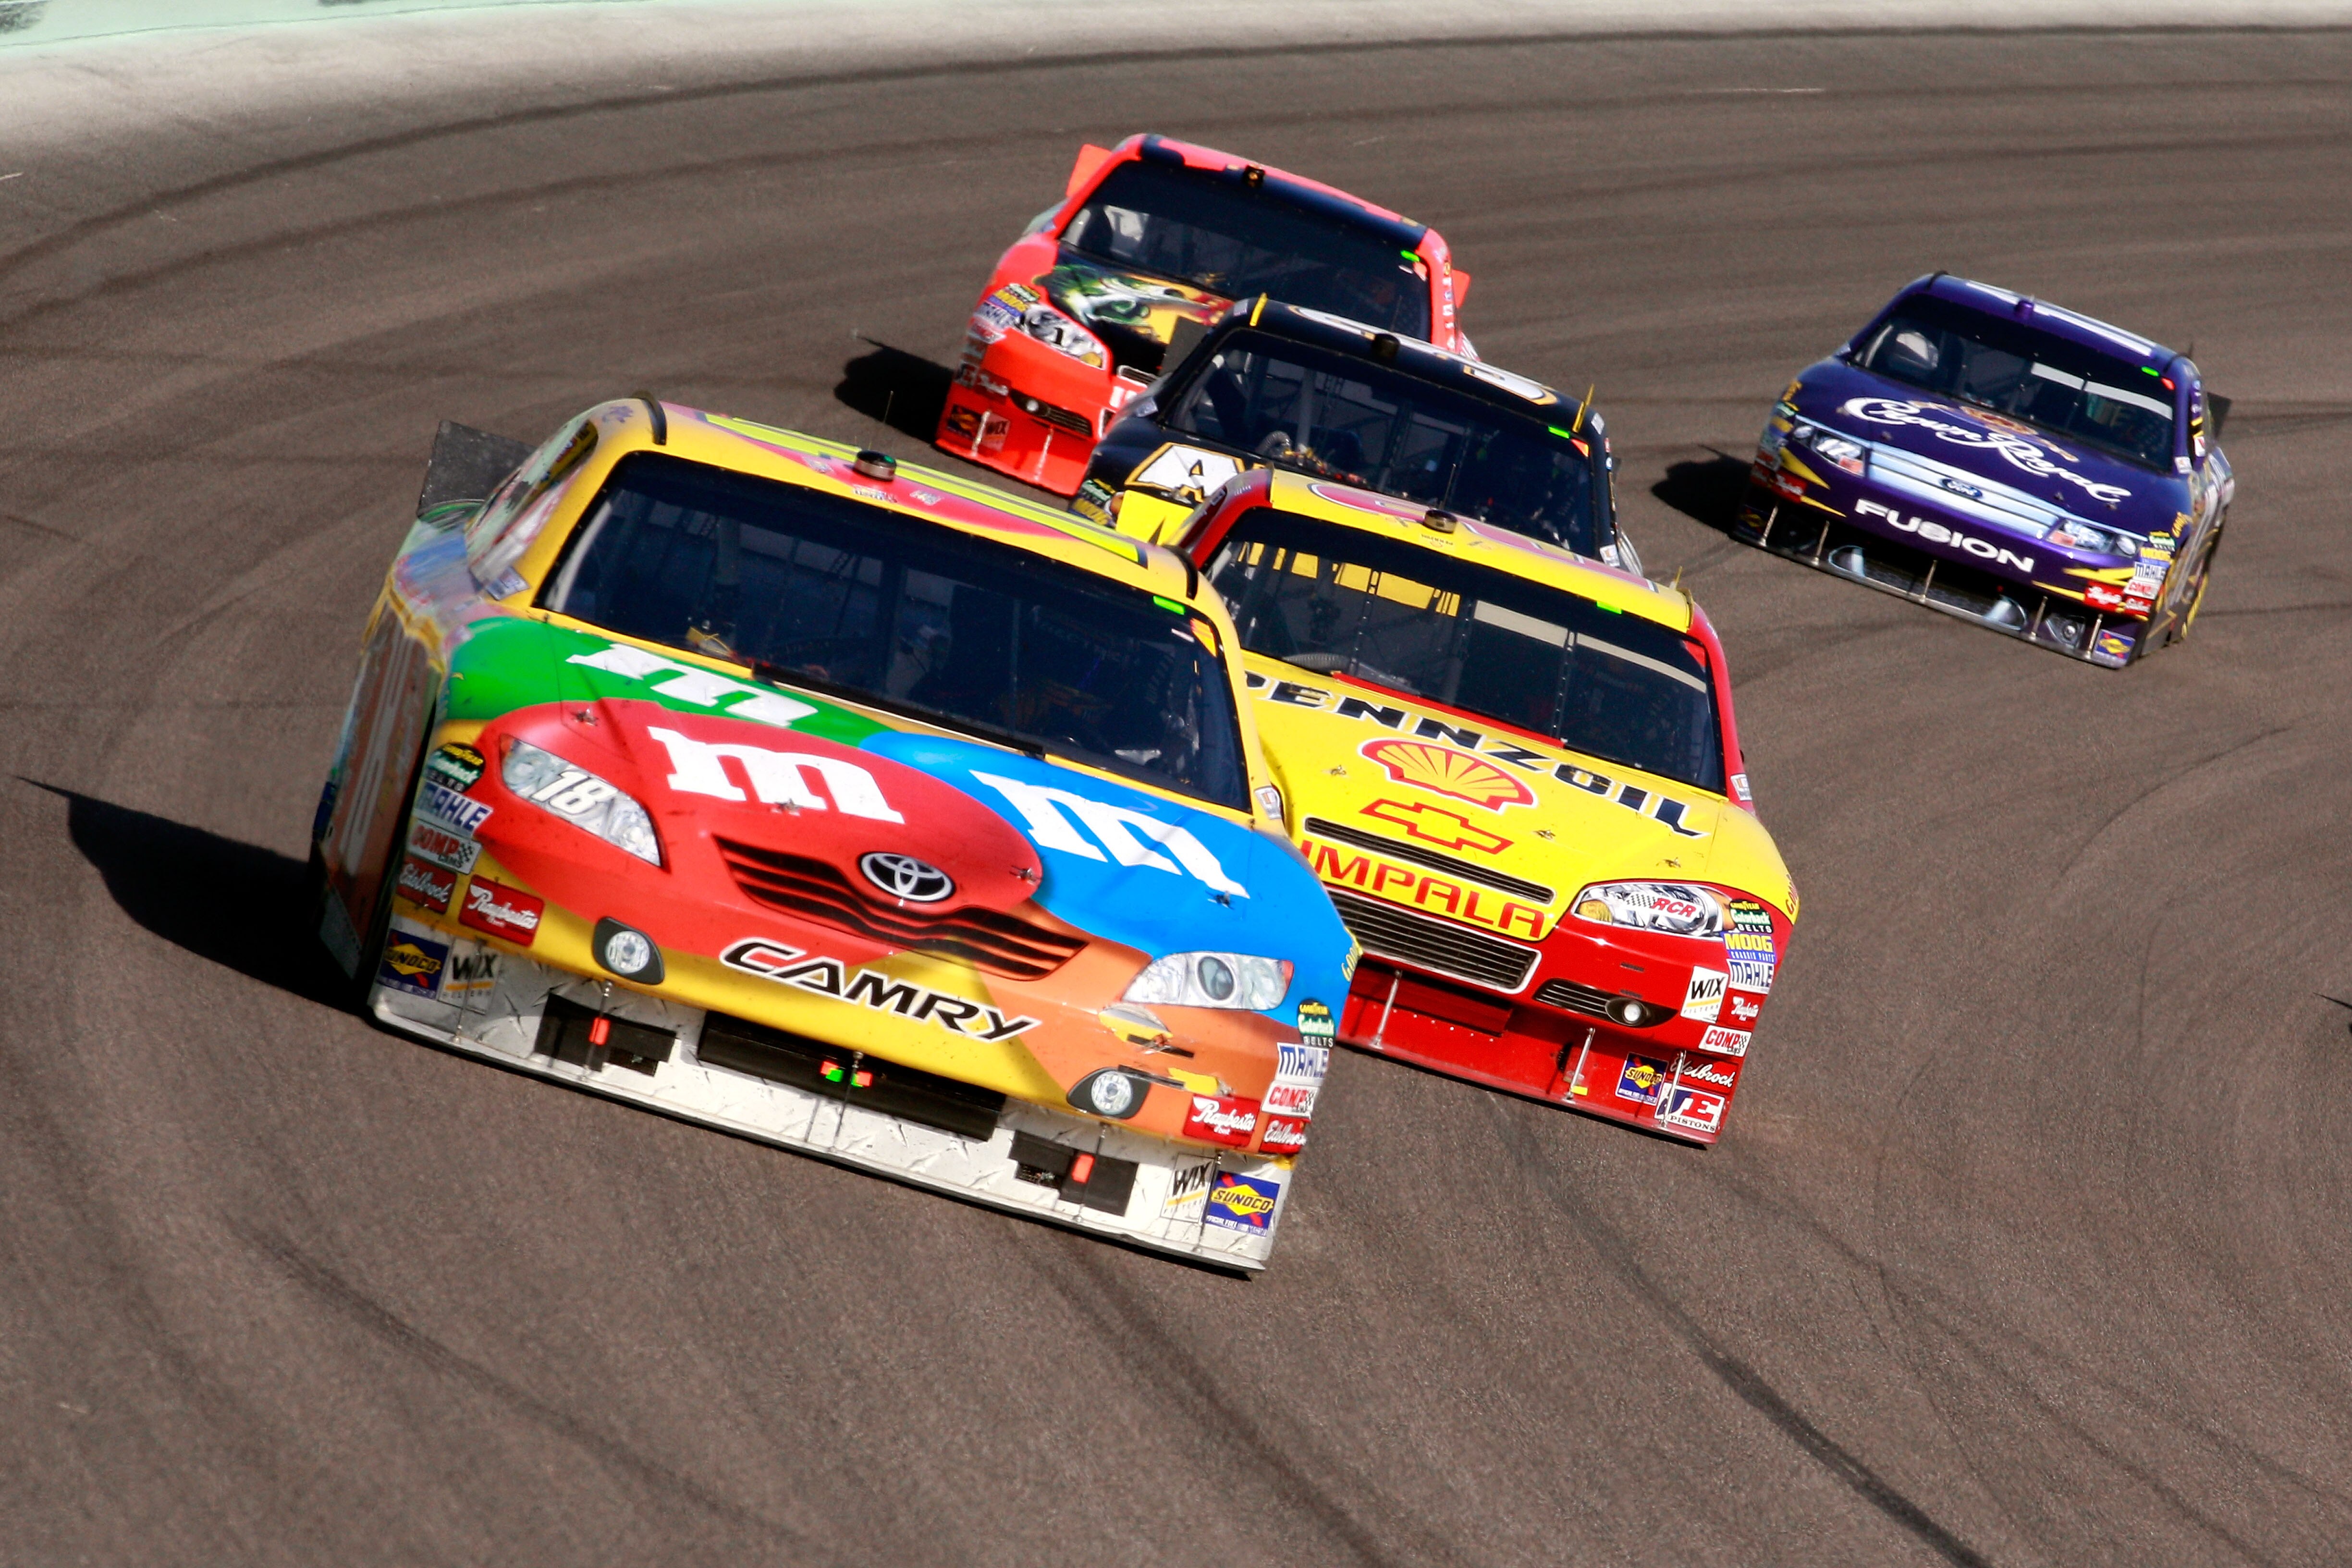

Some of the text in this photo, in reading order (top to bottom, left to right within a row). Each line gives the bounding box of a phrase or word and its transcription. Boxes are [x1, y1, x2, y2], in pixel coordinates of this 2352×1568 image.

[1854, 499, 2035, 573] FUSION
[565, 644, 819, 727] m
[647, 725, 905, 824] m
[532, 770, 616, 815] 18
[968, 770, 1250, 899] m
[1300, 839, 1545, 939] IMPALA
[1650, 897, 1697, 918] RCR
[1737, 923, 1772, 933] BELTS
[1724, 933, 1774, 953] MOOG
[452, 955, 498, 980] WIX
[1729, 961, 1773, 987] MAHLE
[720, 937, 1041, 1043] CAMRY
[1690, 976, 1727, 1000] WIX
[1705, 1029, 1741, 1048] COMP
[1626, 1068, 1662, 1085] SUNOCO
[1670, 1056, 1736, 1088] Edelbrock
[1269, 1085, 1309, 1107] COMP
[1669, 1114, 1716, 1132] PISTONS
[1172, 1160, 1212, 1197] WIX
[1214, 1189, 1271, 1212] SUNOCO
